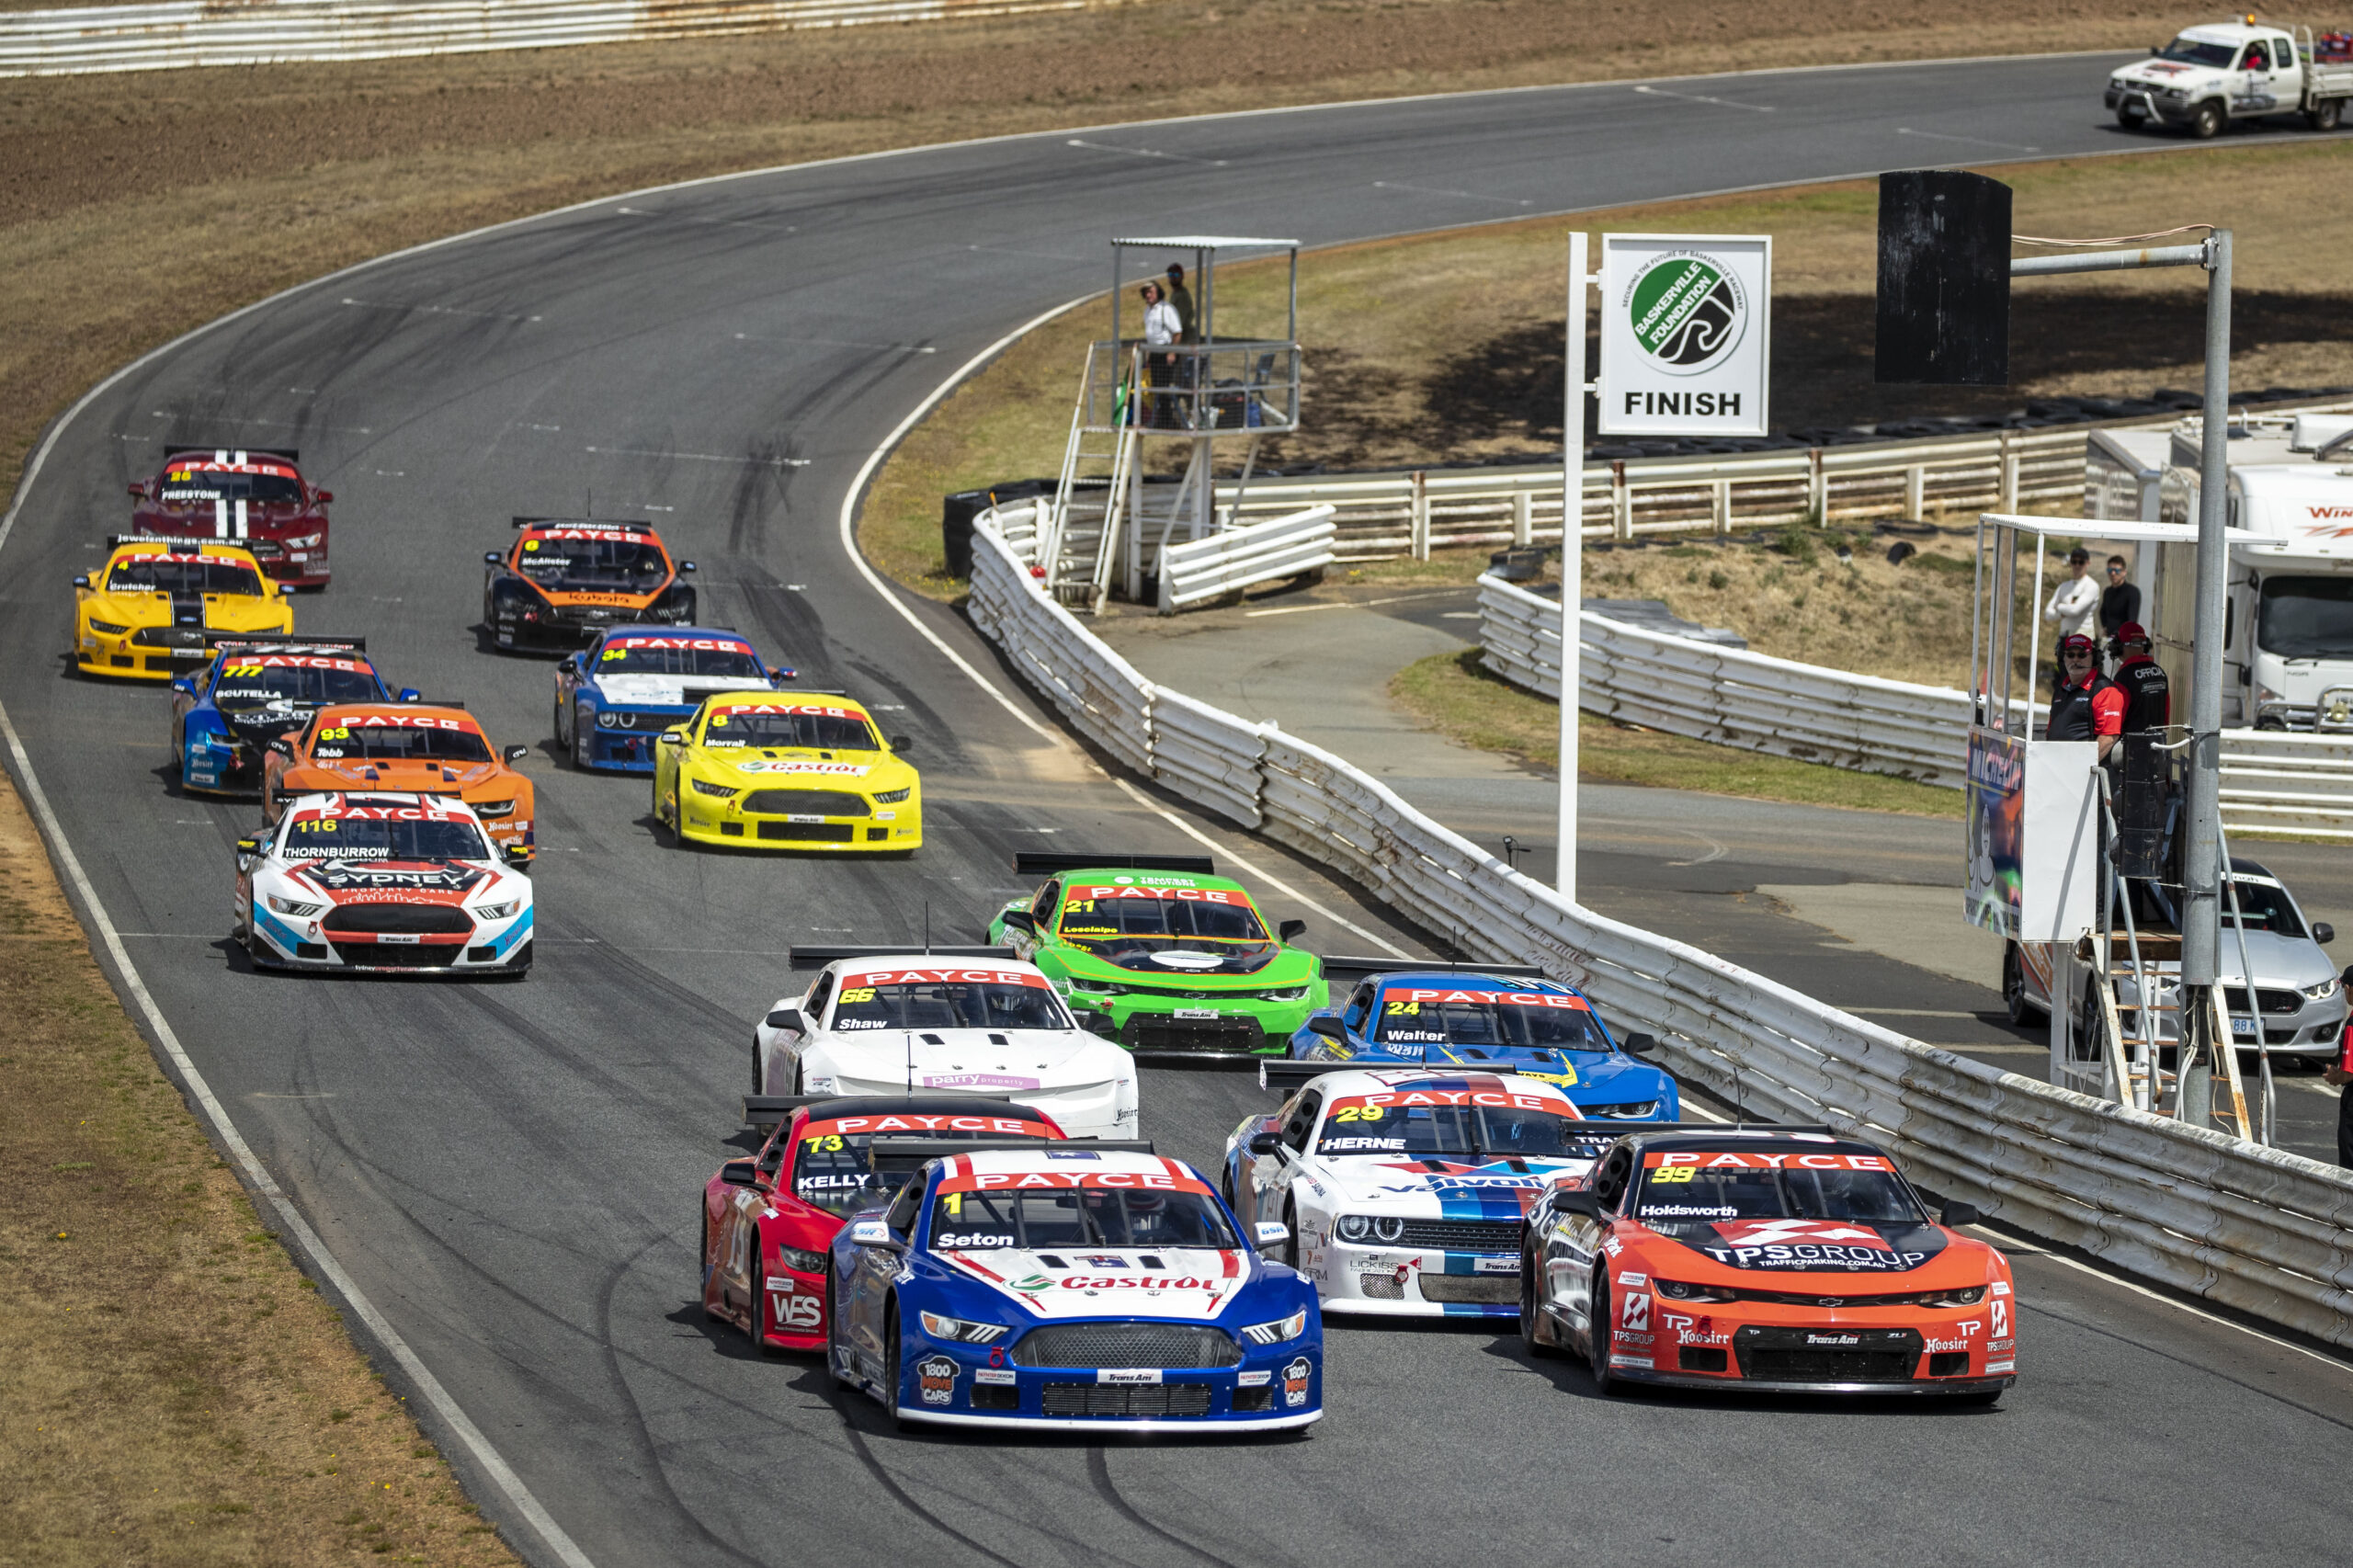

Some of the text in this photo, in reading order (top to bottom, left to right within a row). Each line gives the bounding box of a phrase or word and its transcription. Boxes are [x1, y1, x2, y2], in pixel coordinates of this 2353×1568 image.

[1623, 274, 1640, 308] SECURING
[1639, 262, 1651, 275] THE
[1651, 251, 1677, 266] FUTURE
[1690, 250, 1731, 278] BASKERVILLE
[1729, 278, 1744, 310] RACEWAY
[1634, 261, 1702, 336] BASKERVILLE
[1649, 276, 1711, 345] FOUNDATION
[1625, 392, 1741, 416] FINISH
[186, 462, 278, 475] PAYCE
[162, 490, 221, 500] FREESTONE
[545, 529, 642, 543] PAYCE
[118, 560, 129, 571] 4
[134, 553, 237, 566] PAYCE
[569, 593, 630, 604] Kubota
[627, 639, 738, 653] PAYCE
[602, 649, 627, 661] 34
[241, 656, 356, 672] PAYCE
[223, 665, 265, 678] 777
[215, 689, 283, 699] SCUTELLA
[732, 705, 846, 718] PAYCE
[341, 716, 460, 731] PAYCE
[711, 715, 728, 727] 8
[320, 727, 349, 742] 93
[317, 747, 344, 758] Tebb
[770, 761, 858, 776] Castrol
[321, 808, 449, 821] PAYCE
[297, 819, 338, 833] 116
[284, 846, 390, 858] THORNBURROW
[327, 872, 462, 886] SYDNEY
[1092, 887, 1229, 903] PAYCE
[1064, 901, 1096, 913] 21
[1064, 926, 1119, 934] Loscialpo
[866, 971, 1024, 985] PAYCE
[838, 988, 876, 1004] 66
[1411, 990, 1573, 1007] PAYCE
[1387, 1001, 1420, 1016] 24
[839, 1017, 888, 1029] Shaw
[1387, 1029, 1446, 1042] Walter
[932, 1074, 1024, 1086] parry property
[1364, 1092, 1544, 1110] PAYCE
[1336, 1105, 1384, 1123] 29
[837, 1117, 1025, 1133] PAYCE
[805, 1135, 844, 1153] 73
[1324, 1138, 1406, 1150] HERNE
[1662, 1153, 1886, 1171] PAYCE
[798, 1174, 871, 1189] KELLY
[975, 1173, 1176, 1189] PAYCE
[1651, 1166, 1697, 1184] 99
[943, 1193, 961, 1214] 1
[1640, 1205, 1738, 1217] Holdsworth
[938, 1233, 1014, 1247] Seton
[1704, 1244, 1926, 1266] TPSGROUP
[1758, 1258, 1886, 1269] TRAFFICPARKING.COM.AU
[1061, 1276, 1218, 1290] Castrol
[772, 1293, 822, 1327] WES
[1613, 1330, 1654, 1345] TPSGROUP
[1677, 1330, 1729, 1345] Hoosier
[1807, 1335, 1859, 1345] Trans Am
[1923, 1336, 1968, 1354] Hoosier
[925, 1363, 950, 1377] 1800
[1108, 1373, 1134, 1381] Trans
[1289, 1364, 1306, 1380] 1800
[922, 1375, 952, 1391] MOVE
[1286, 1379, 1307, 1392] MOVE
[923, 1389, 950, 1403] CARS
[1288, 1391, 1306, 1404] CARS
